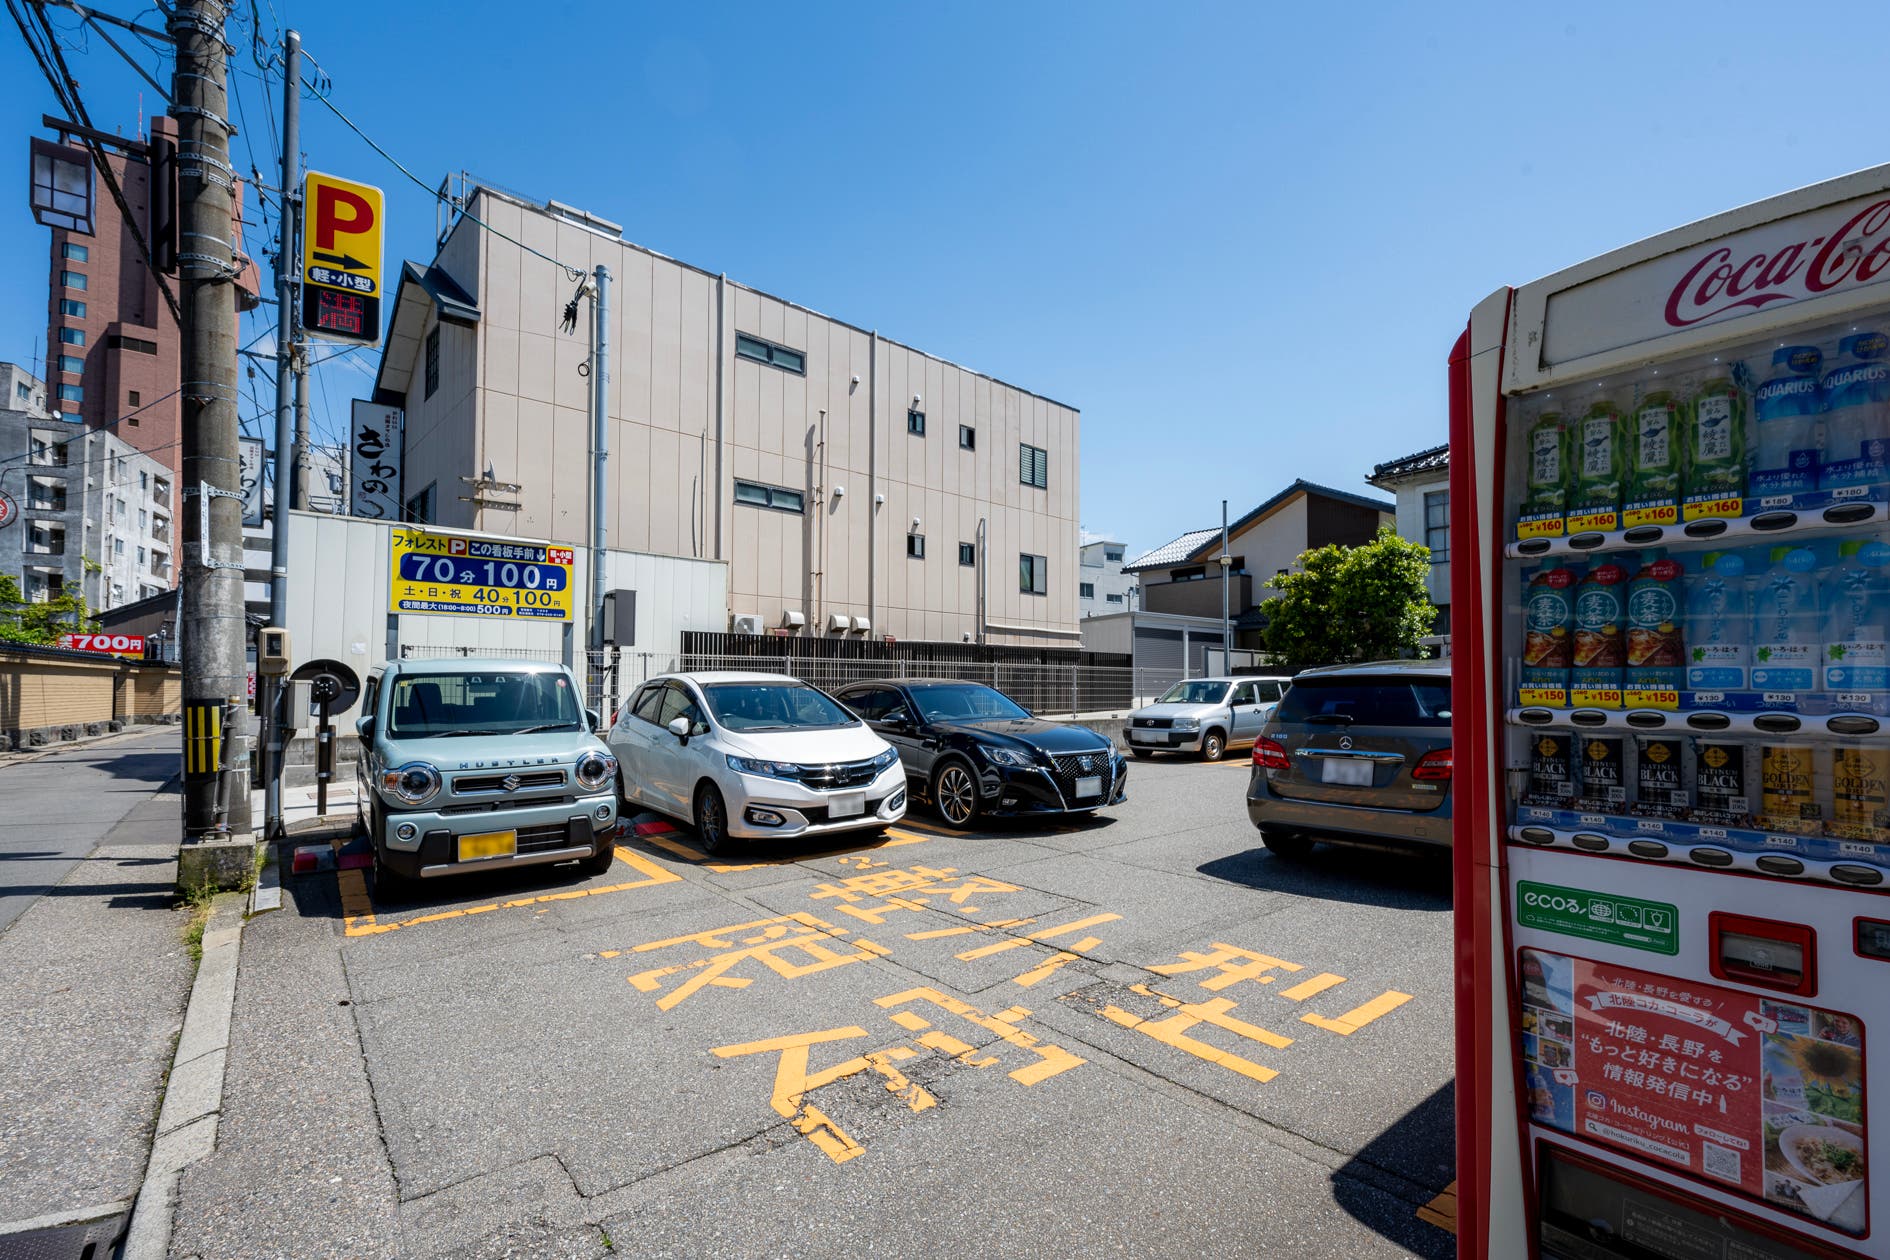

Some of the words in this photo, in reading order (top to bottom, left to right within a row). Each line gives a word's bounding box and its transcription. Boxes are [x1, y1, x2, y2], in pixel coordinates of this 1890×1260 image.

[316, 184, 374, 250] P
[1707, 499, 1740, 513] ¥160
[1587, 515, 1615, 526] ¥160
[1645, 508, 1675, 520] ¥160
[1536, 520, 1562, 532] ¥160
[393, 535, 446, 551] フォレスト
[451, 539, 466, 554] P
[471, 542, 535, 560] この看板手前
[412, 555, 475, 584] 70分
[484, 561, 558, 590] 100円
[1538, 597, 1553, 626] 麦茶
[1587, 595, 1602, 625] 麦茶
[1641, 592, 1659, 622] 麦茶
[1539, 690, 1564, 700] ¥150
[1592, 690, 1619, 701] ¥150
[1646, 691, 1676, 703] ¥150
[459, 757, 559, 769] HUSTLER
[1534, 761, 1566, 774] BLACK
[1583, 767, 1617, 779] BLACK
[1640, 769, 1679, 782] BLACK
[1763, 773, 1809, 786] GOLDEN
[1697, 774, 1739, 787] BLACK
[1834, 777, 1886, 792] GOLDEN
[1604, 1020, 1724, 1064] 北陸・長野を
[1602, 1062, 1713, 1107] 情報発信中
[1610, 1099, 1690, 1135] Instagram
